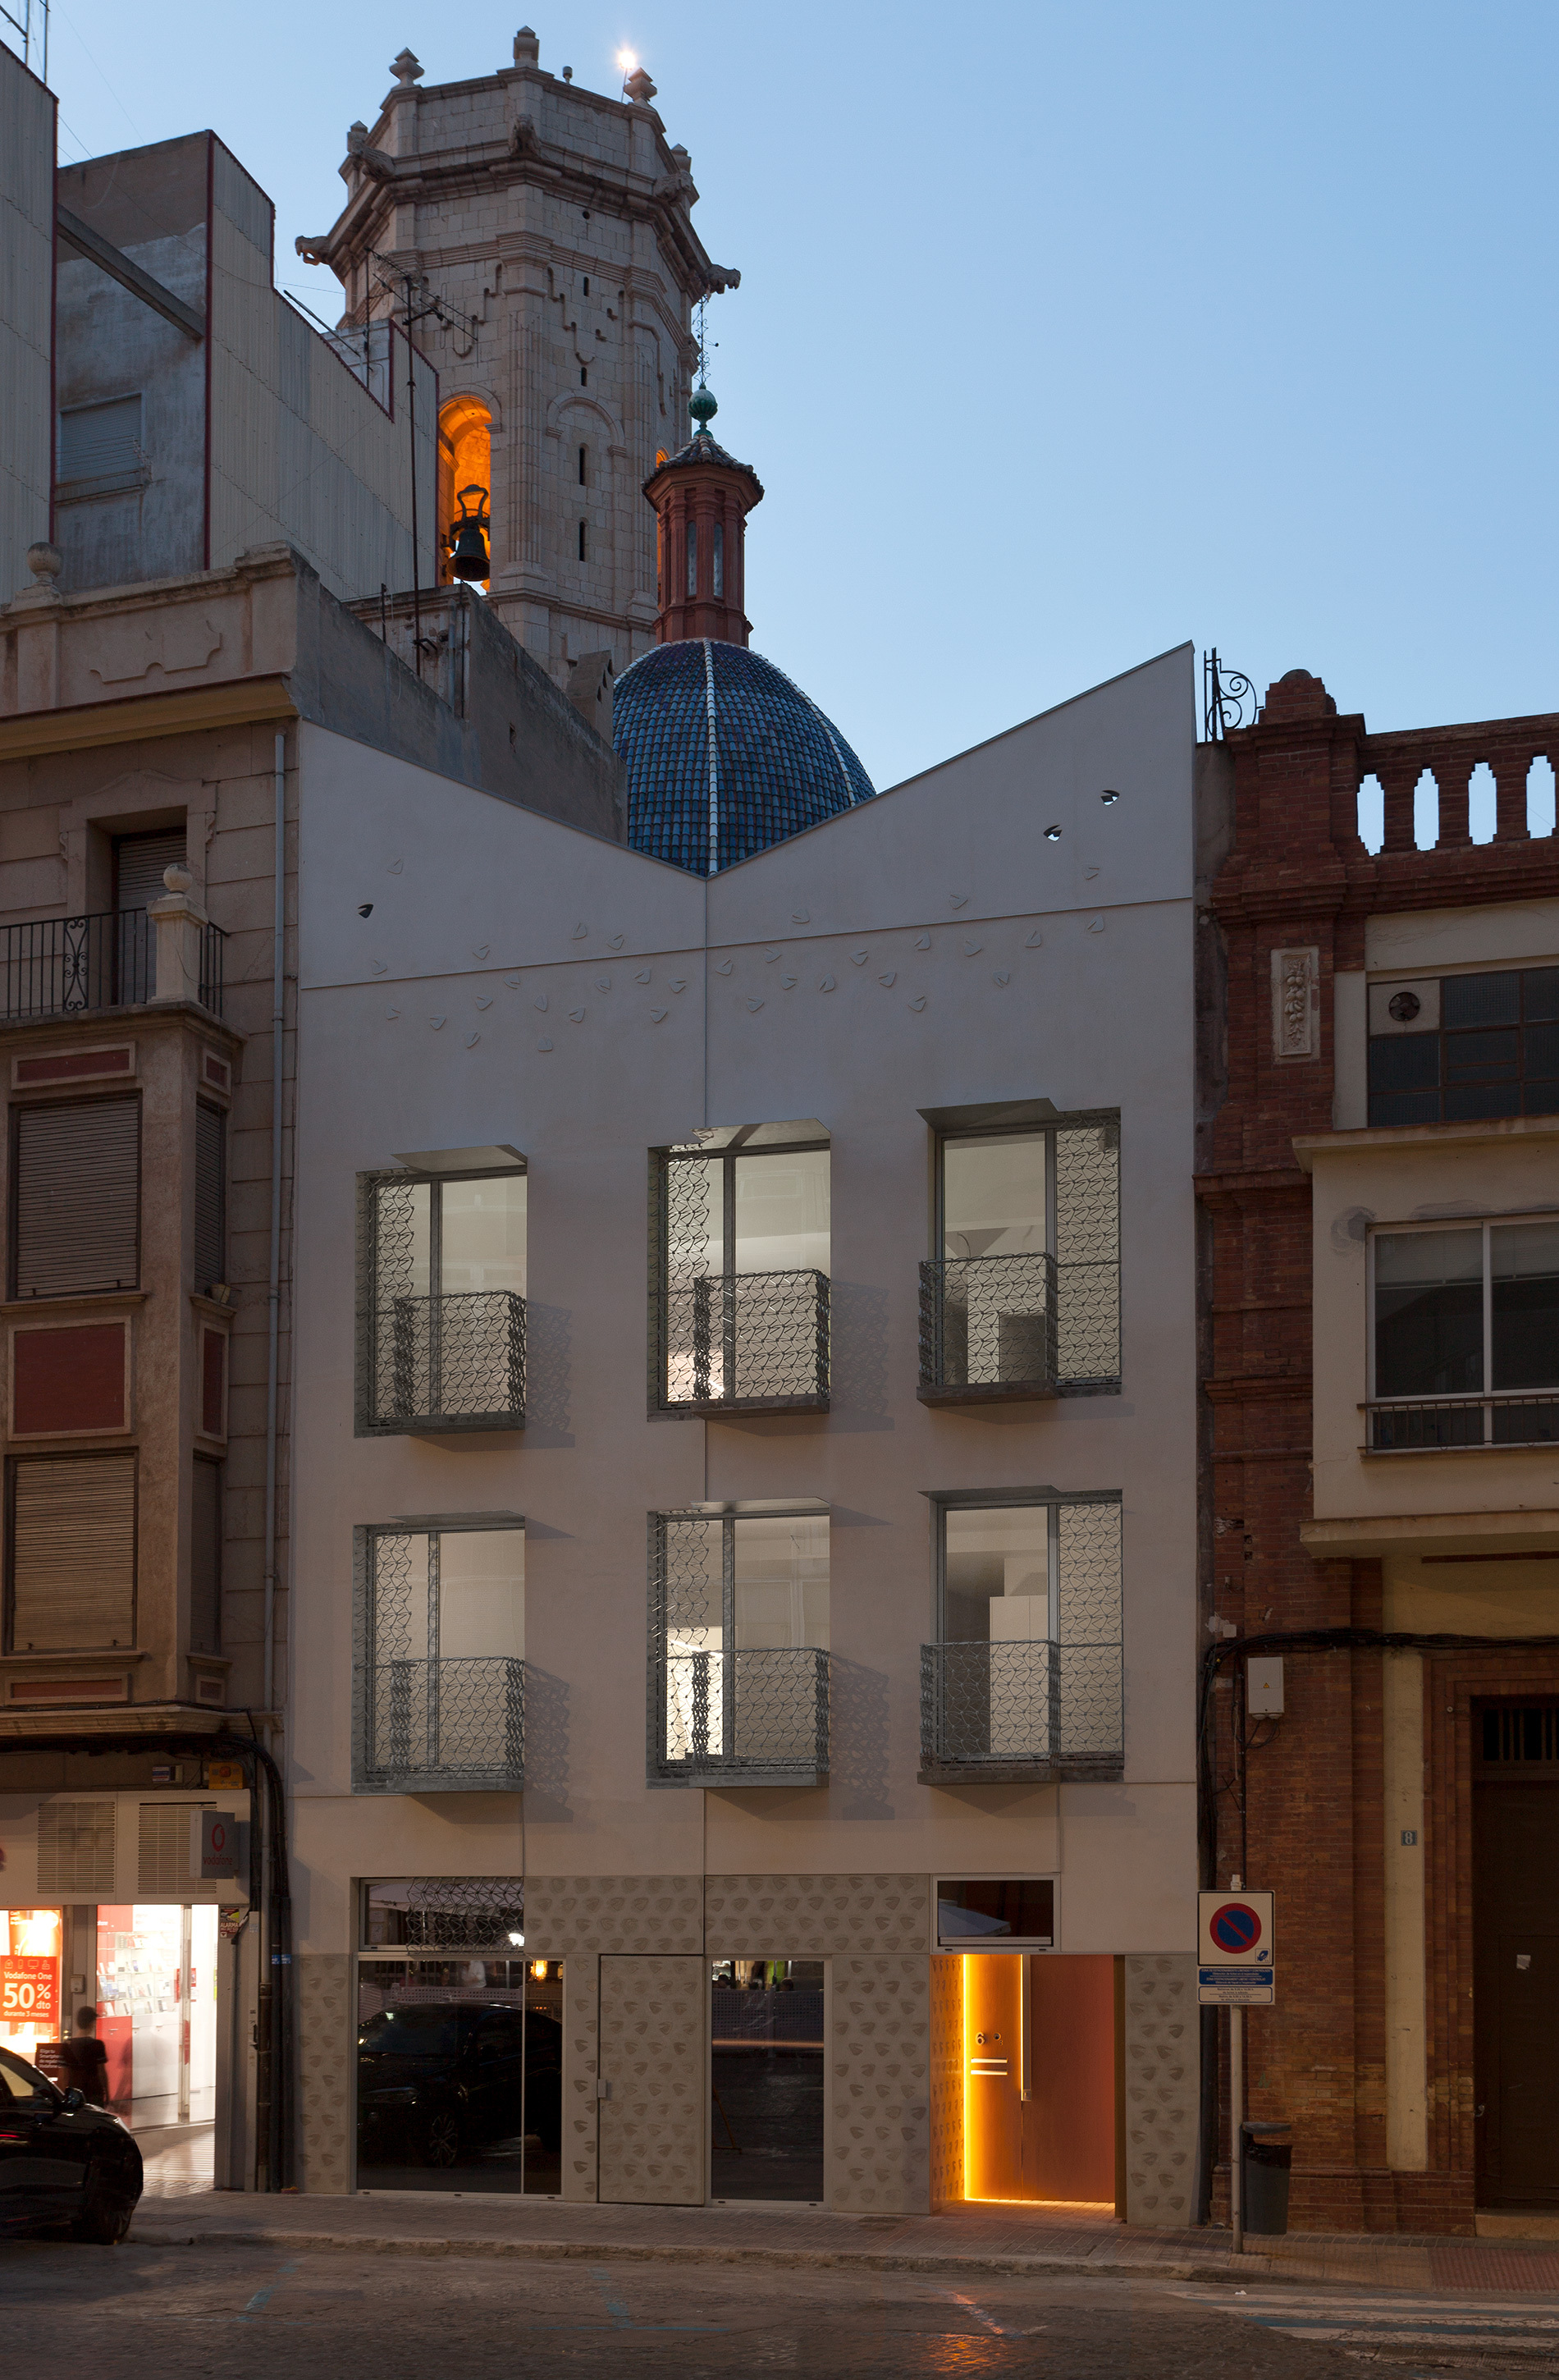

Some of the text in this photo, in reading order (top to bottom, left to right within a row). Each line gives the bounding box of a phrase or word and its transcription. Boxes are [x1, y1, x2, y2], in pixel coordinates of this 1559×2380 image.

[1405, 1831, 1413, 1845] 8
[203, 1855, 233, 1865] vodafone
[3, 1971, 53, 1980] Vodafone One
[35, 2000, 51, 2009] dto
[976, 2032, 985, 2045] 6
